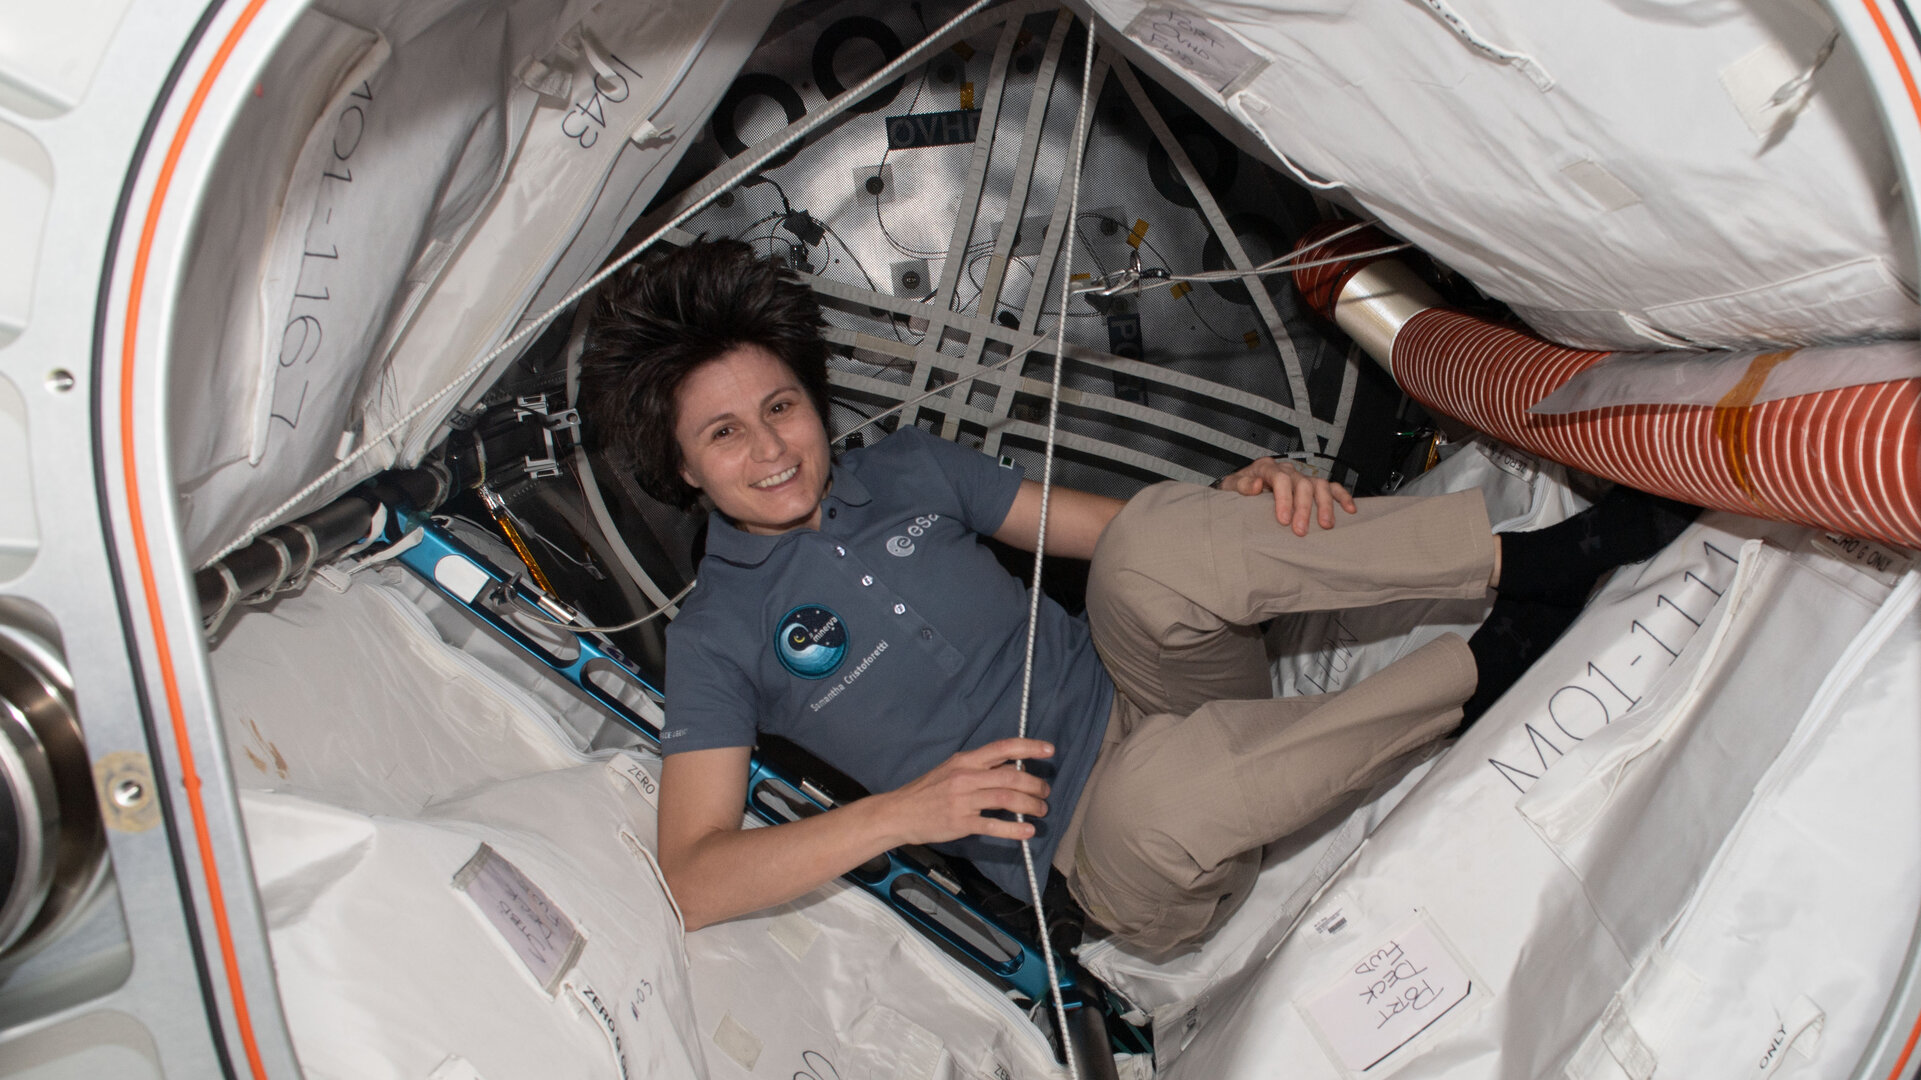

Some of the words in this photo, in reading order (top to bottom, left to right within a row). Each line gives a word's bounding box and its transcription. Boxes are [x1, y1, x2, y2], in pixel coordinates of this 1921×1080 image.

[562, 54, 643, 149] 1043
[812, 616, 839, 642] minerva
[810, 683, 846, 712] Samantha
[843, 639, 889, 685] Cristoforetti
[627, 764, 657, 795] ZERO
[1355, 940, 1404, 975] FWD
[1359, 959, 1428, 1005] DECK
[1377, 979, 1444, 1029] PORT
[583, 985, 615, 1033] ZERO
[1759, 1023, 1786, 1069] ONLY
